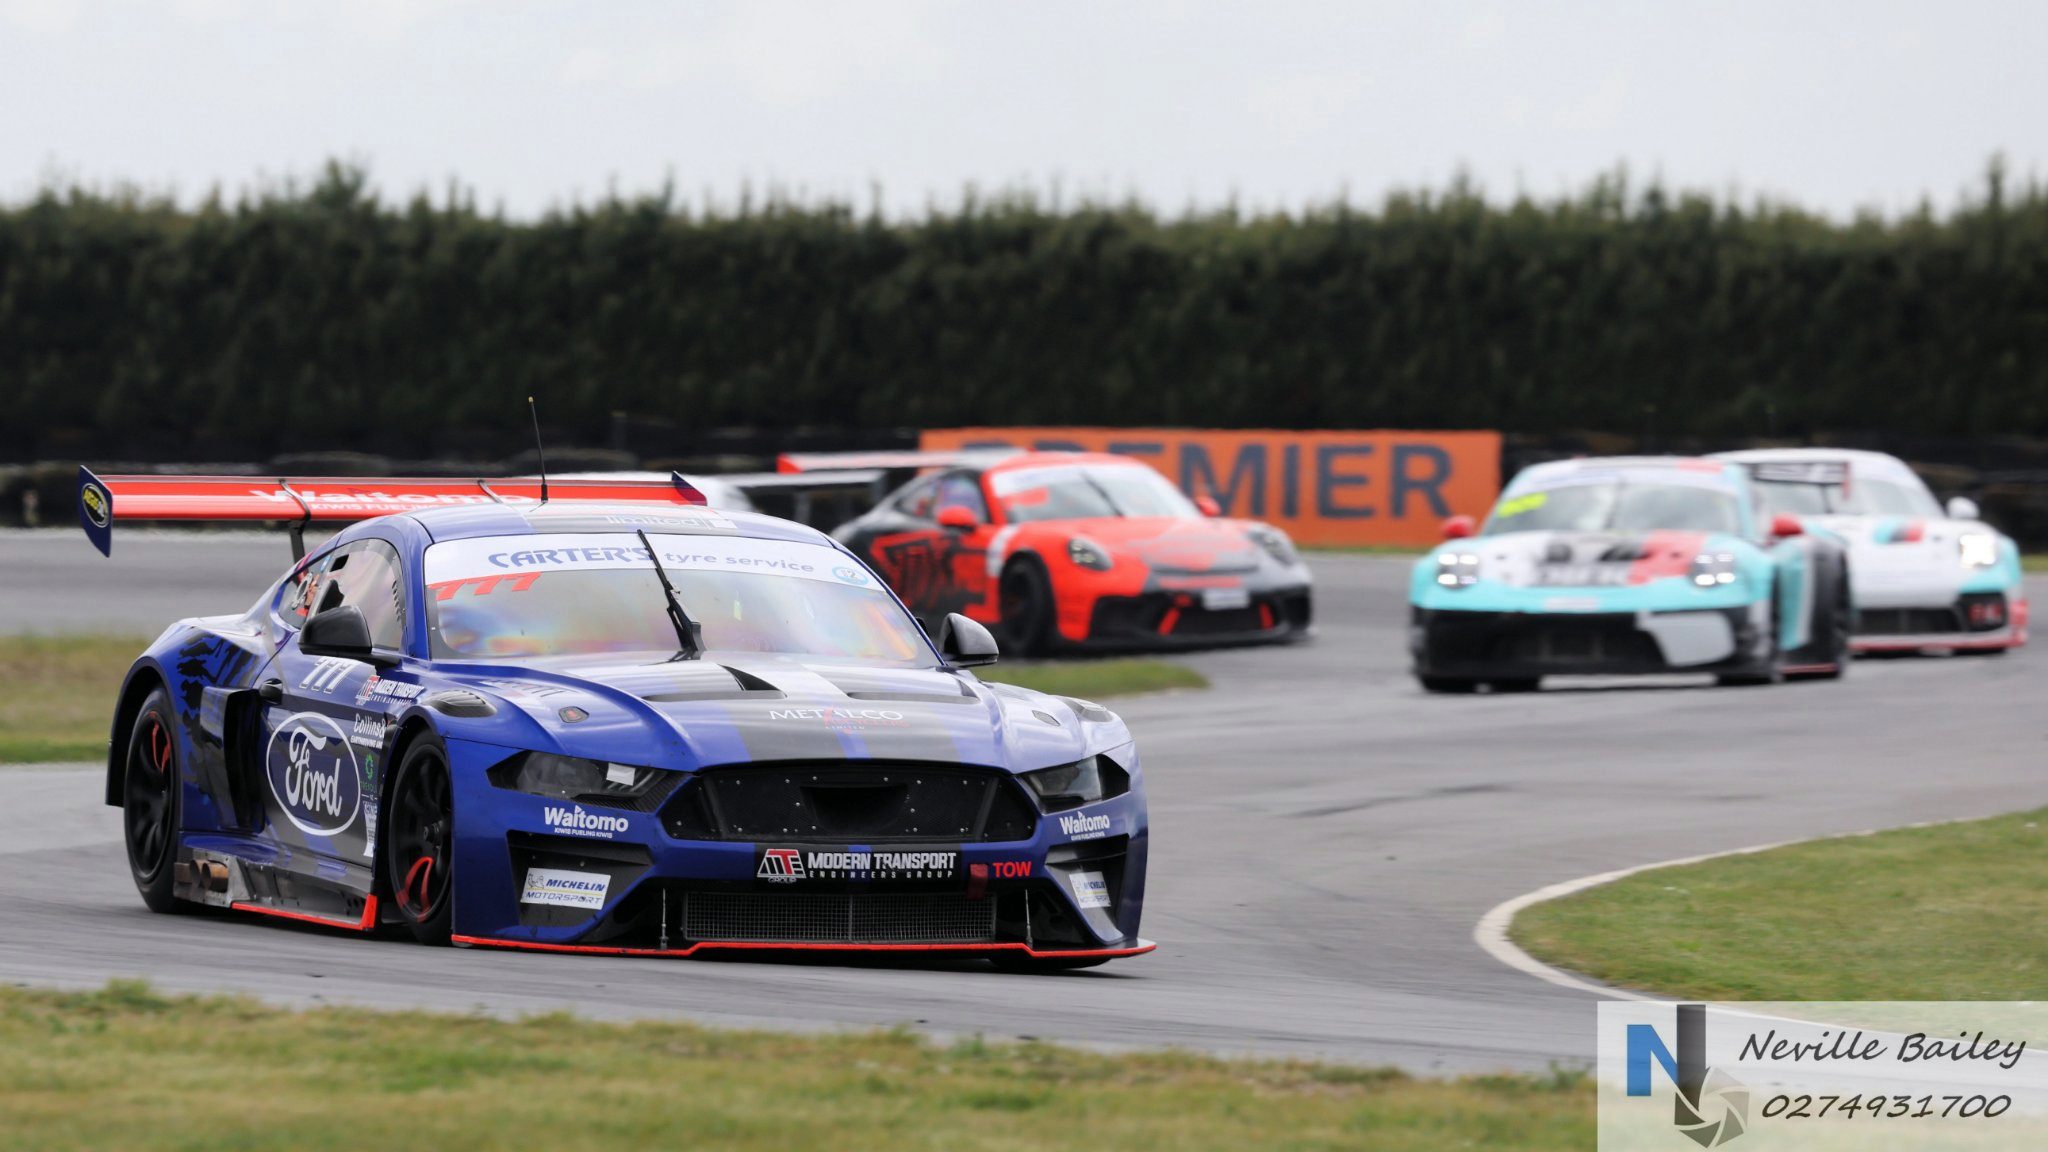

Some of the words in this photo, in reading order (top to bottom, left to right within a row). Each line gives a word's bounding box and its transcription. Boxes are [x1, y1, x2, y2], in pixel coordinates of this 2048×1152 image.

[488, 547, 653, 568] CARTER'S
[664, 551, 717, 564] tyre
[726, 554, 814, 573] service
[427, 571, 542, 601] 777
[285, 726, 342, 818] Ford
[544, 805, 629, 832] Waitomo
[1059, 811, 1110, 835] Waitomo
[808, 852, 871, 869] MODERN
[873, 852, 956, 870] TRANSPORT
[993, 860, 1032, 878] TOW
[809, 870, 896, 879] ENGINEERS
[906, 871, 953, 879] GROUP
[546, 879, 605, 892] MICHELIN
[526, 891, 602, 904] MOTORSPORT
